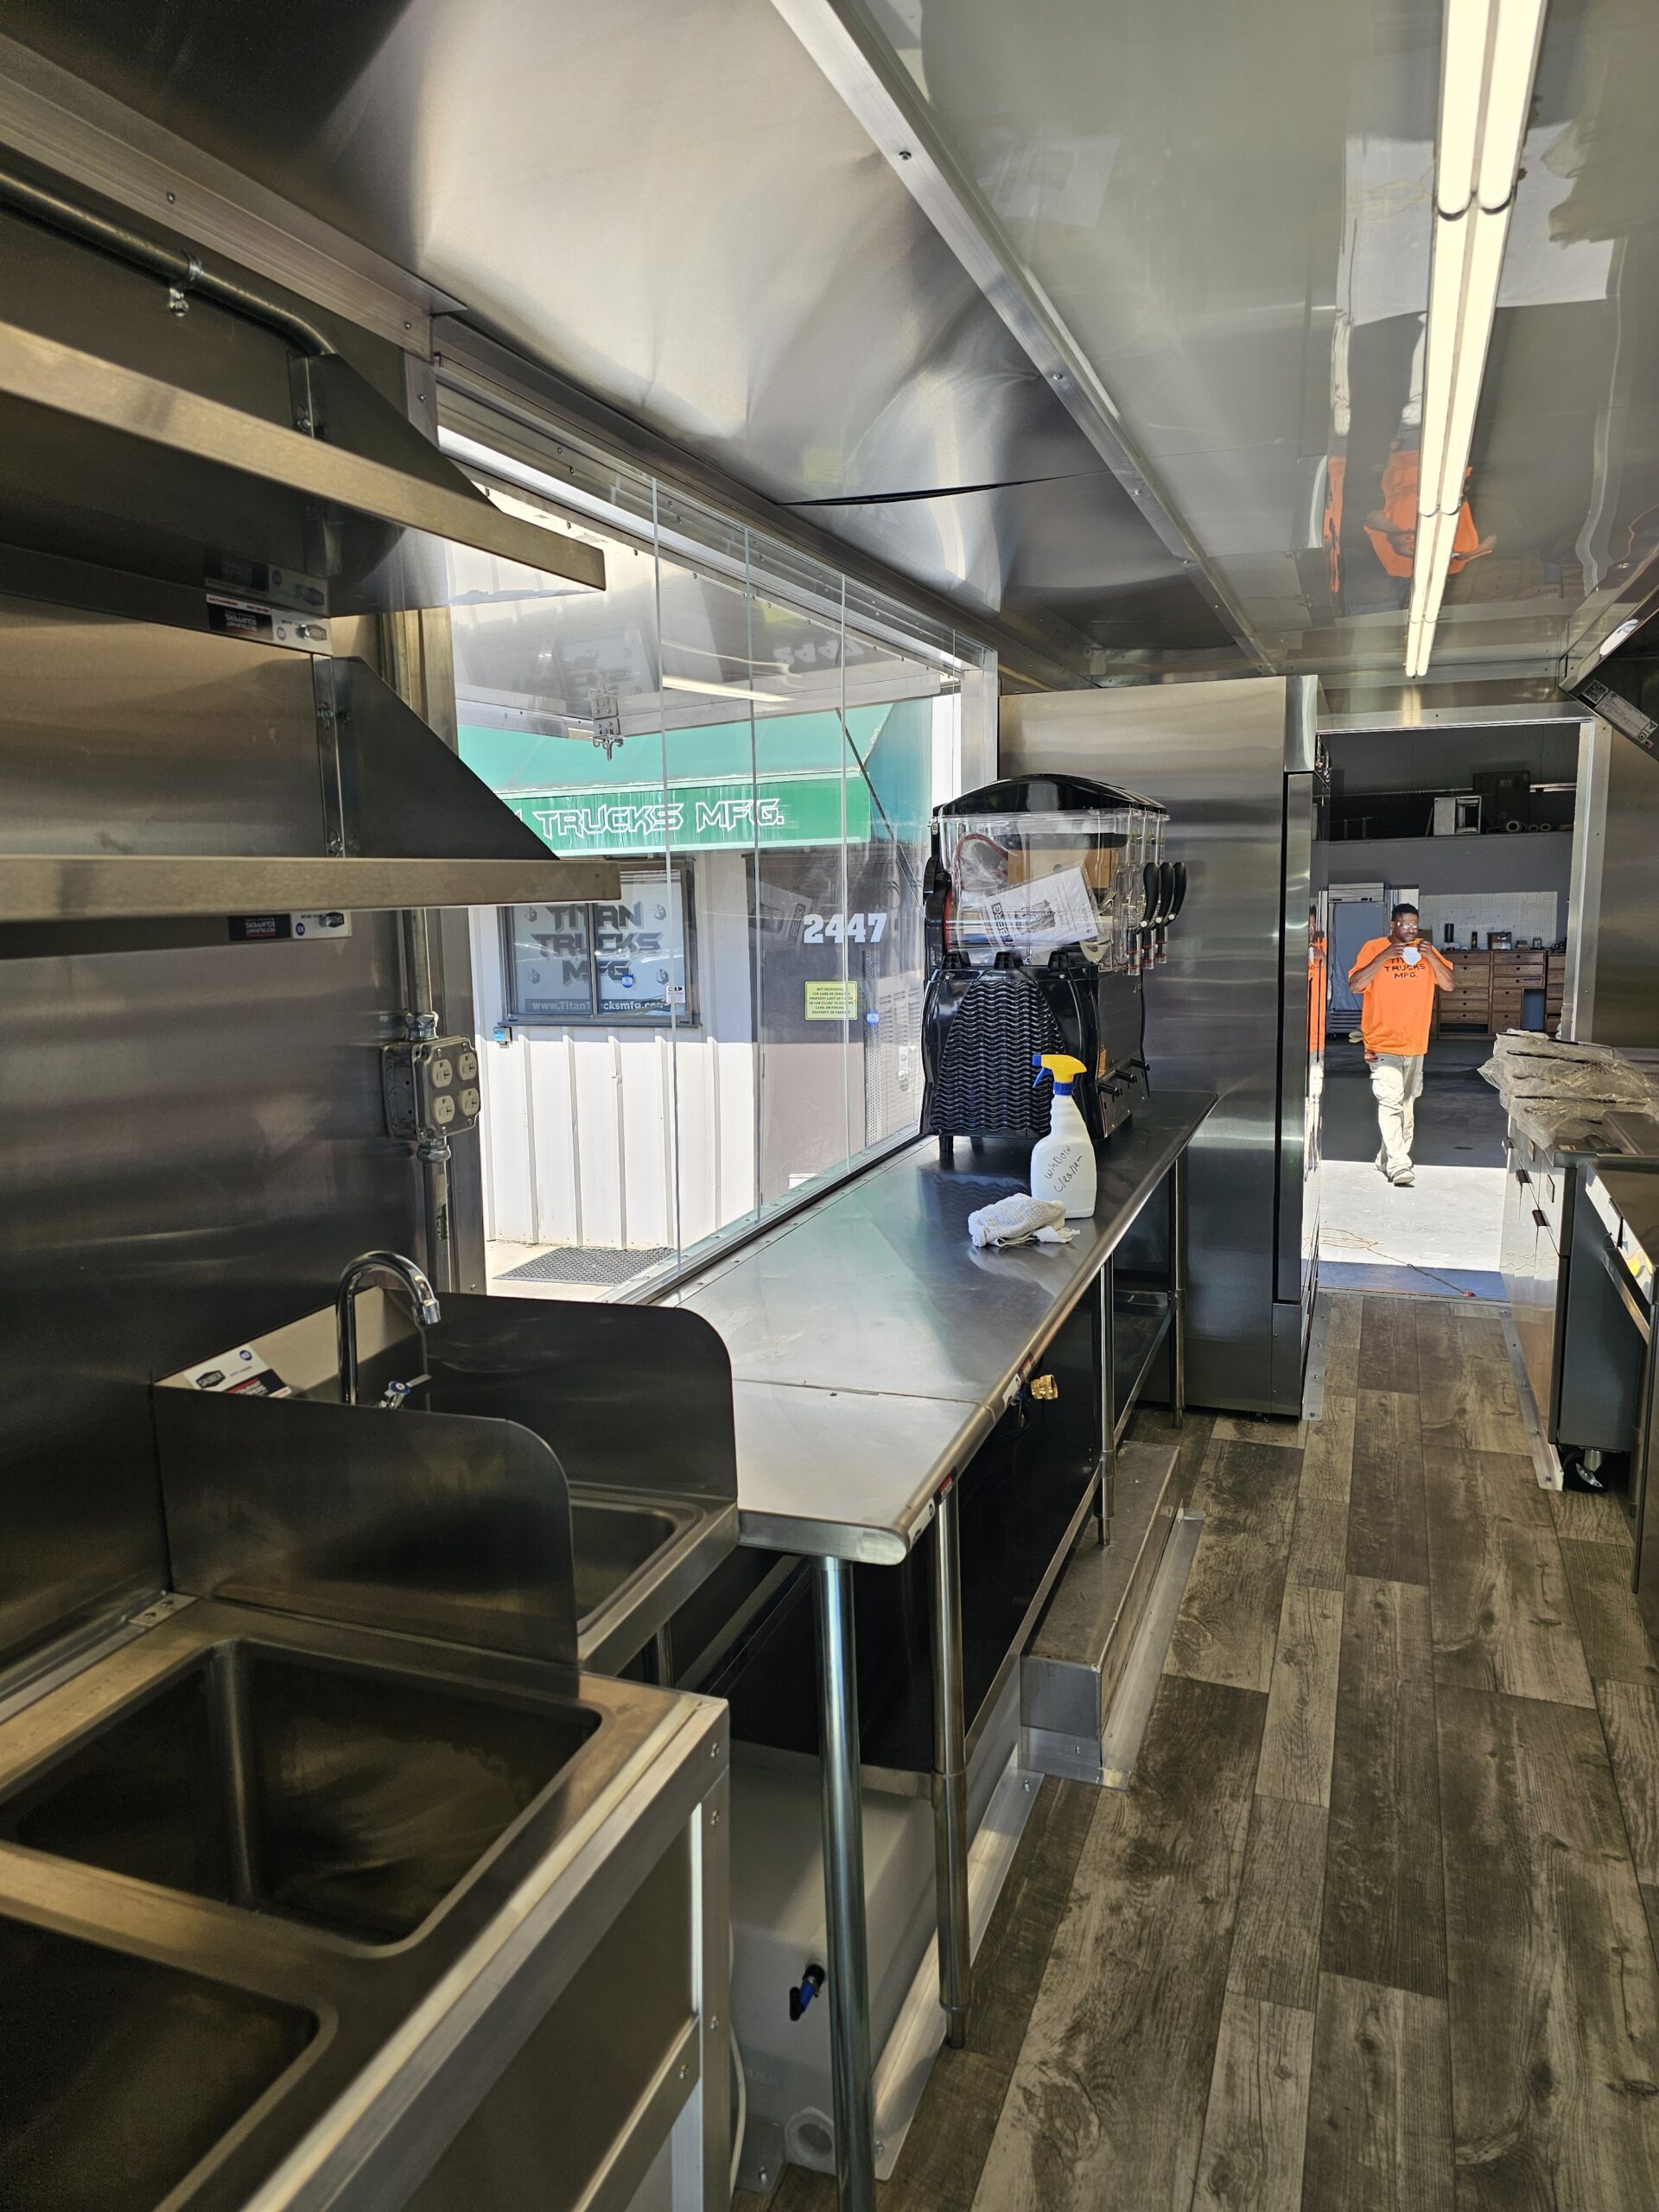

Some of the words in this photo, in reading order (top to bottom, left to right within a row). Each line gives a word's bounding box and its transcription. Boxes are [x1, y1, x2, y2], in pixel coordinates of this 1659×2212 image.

[532, 801, 684, 842] TRUCKS
[696, 798, 785, 833] MFG.
[804, 912, 887, 944] 2447
[1383, 963, 1426, 973] TRUCKS
